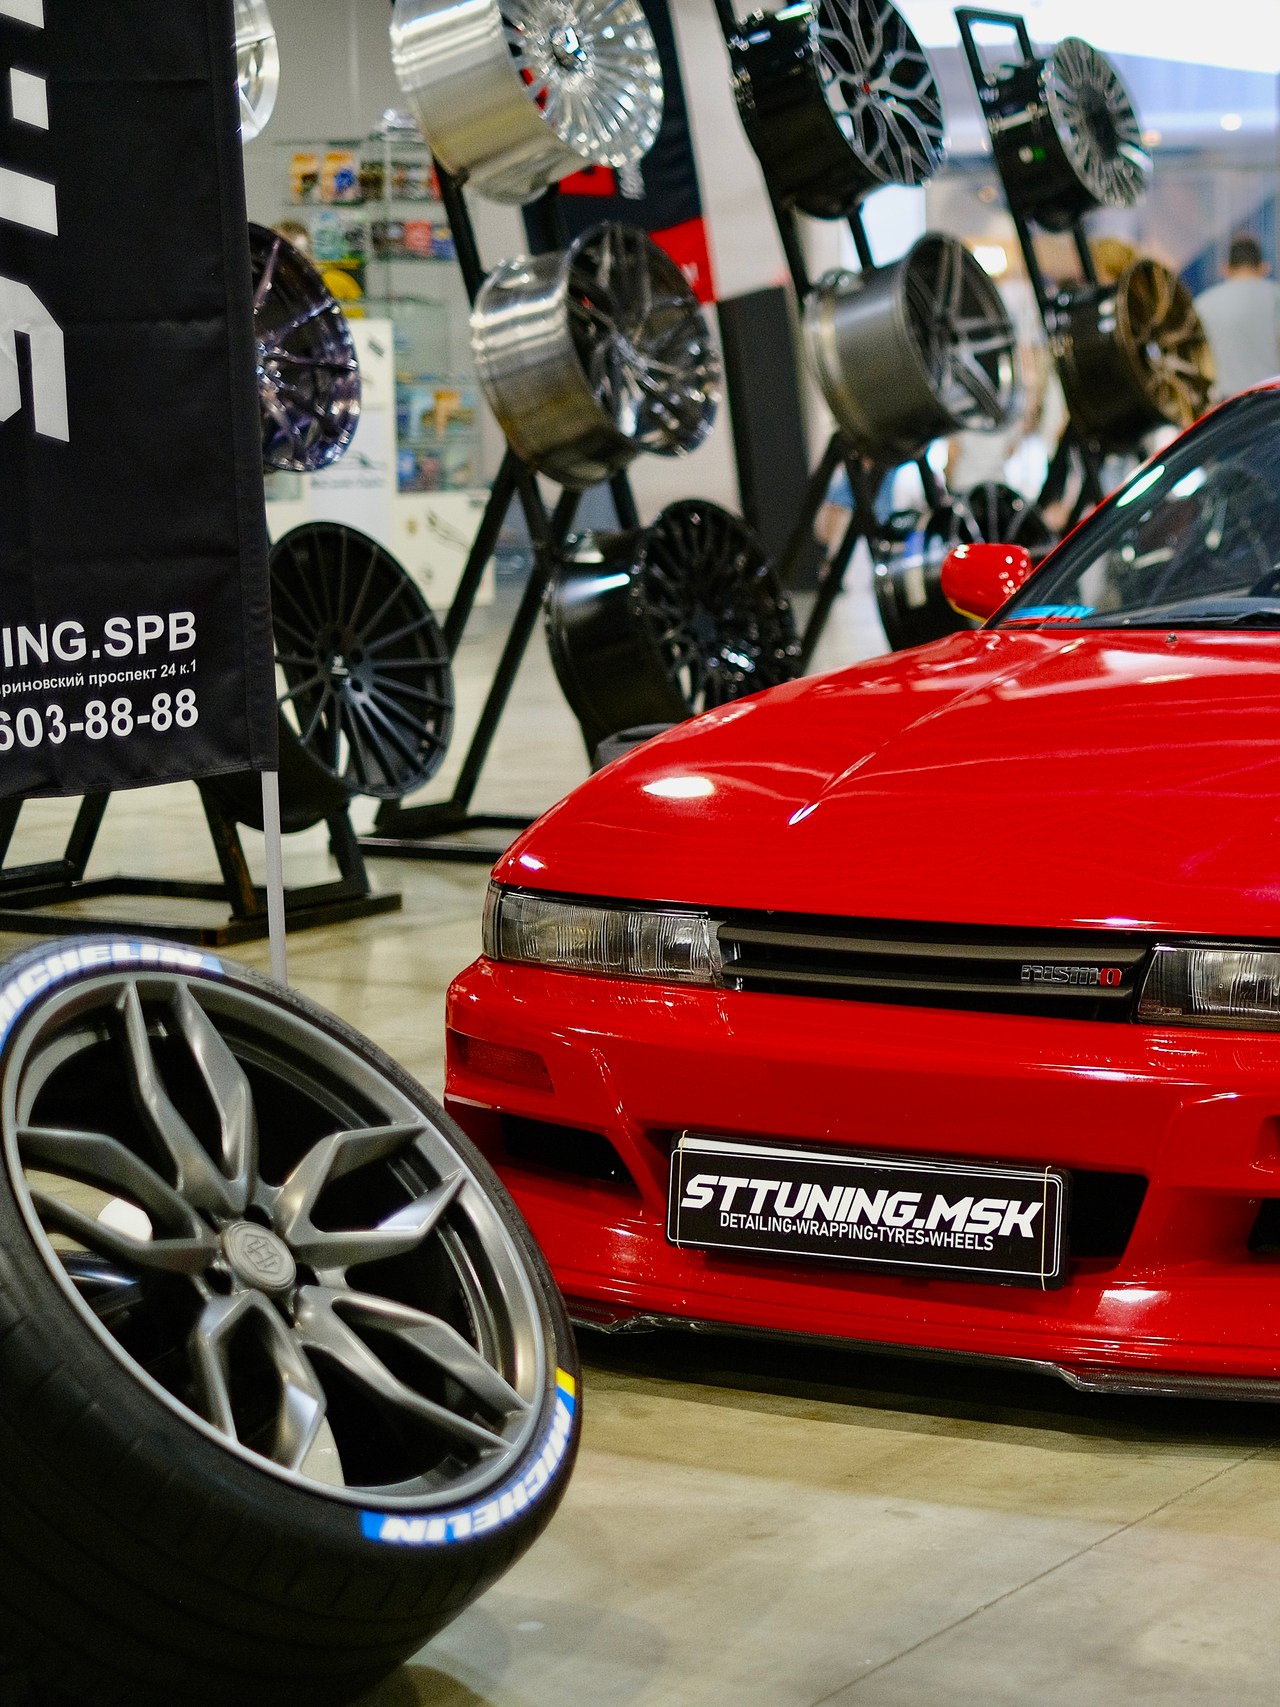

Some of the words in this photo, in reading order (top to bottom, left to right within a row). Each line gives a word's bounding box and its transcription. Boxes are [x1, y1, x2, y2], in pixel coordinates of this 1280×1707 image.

[2, 611, 197, 668] ING.SPB
[0, 672, 85, 697] риновский
[89, 668, 158, 687] проспект
[160, 663, 177, 678] 24
[681, 1174, 1044, 1239] STTUNING.MSK
[379, 1397, 572, 1542] MICHELIN
